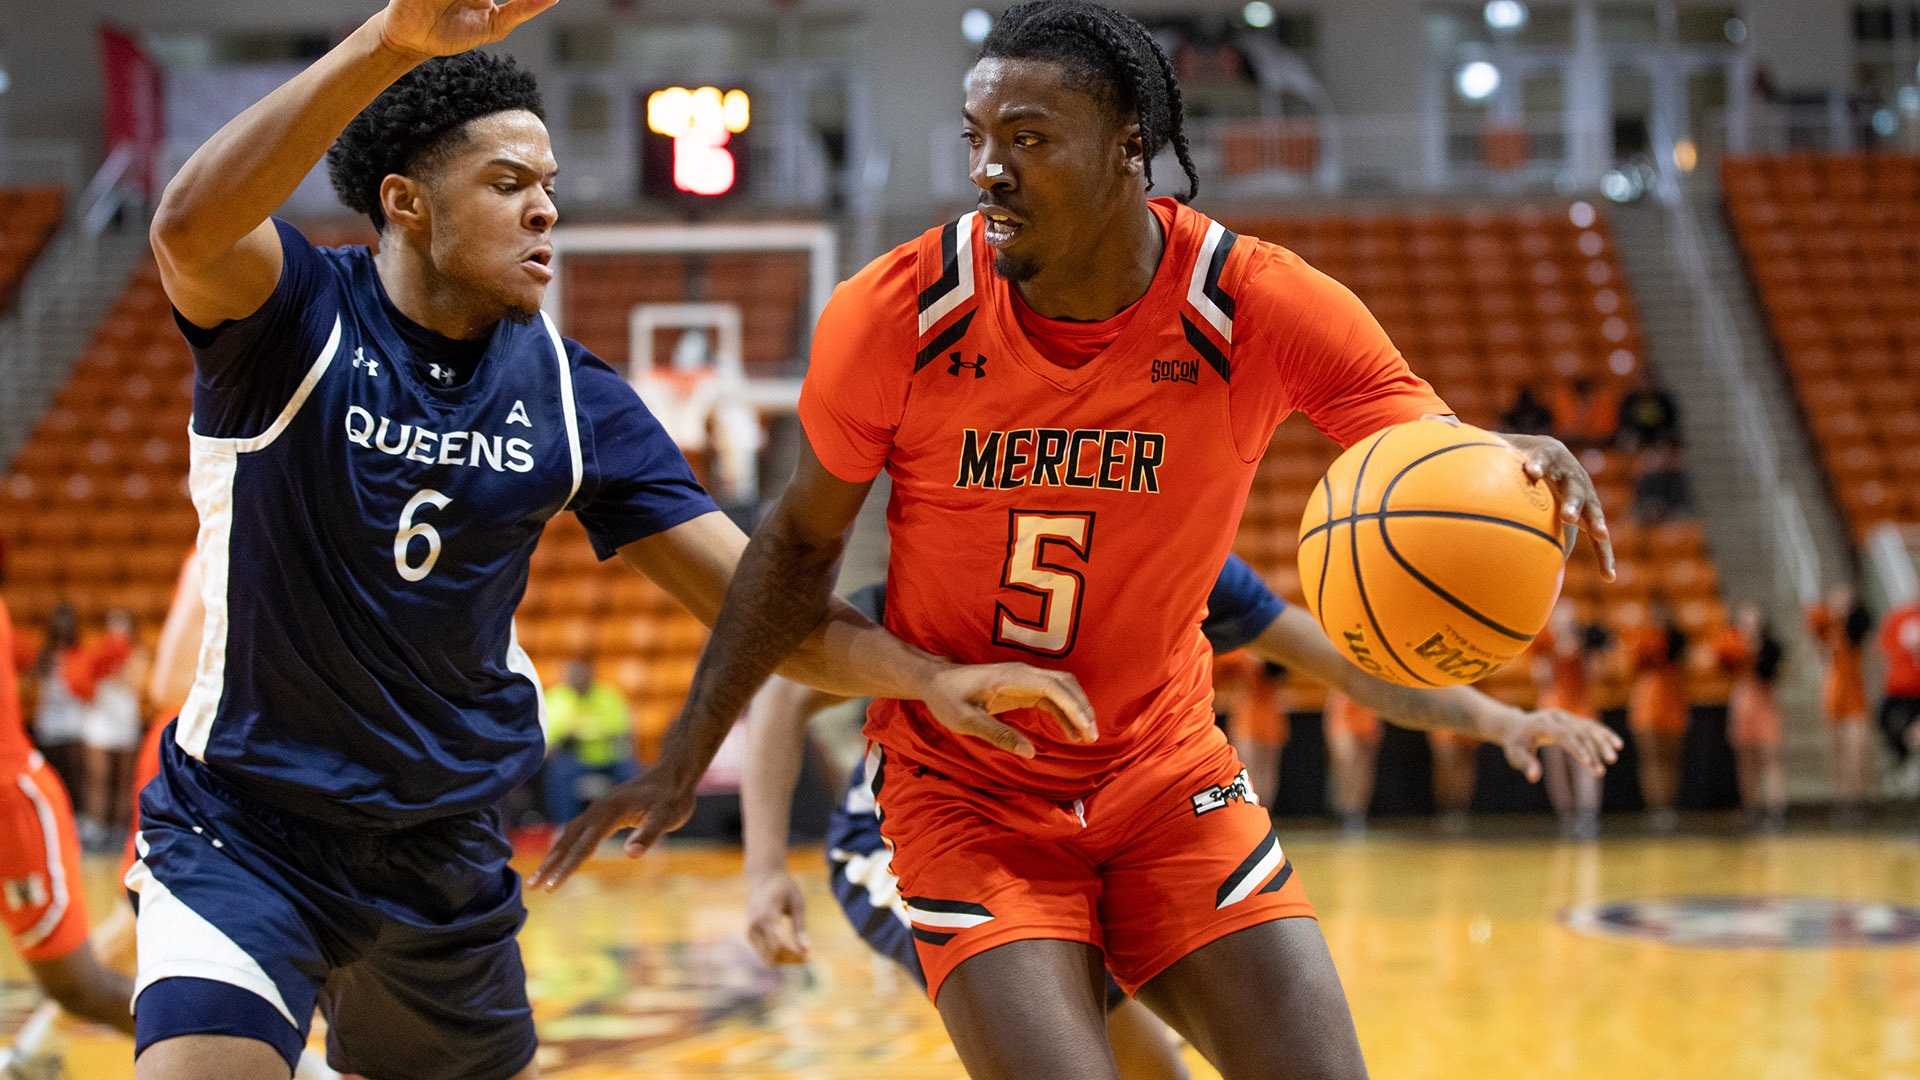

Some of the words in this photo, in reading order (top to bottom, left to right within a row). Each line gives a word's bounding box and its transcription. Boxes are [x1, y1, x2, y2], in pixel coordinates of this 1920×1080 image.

[345, 406, 535, 473] QUEENS
[953, 428, 1166, 494] MERCER
[394, 489, 453, 582] 6
[992, 508, 1096, 659] 5
